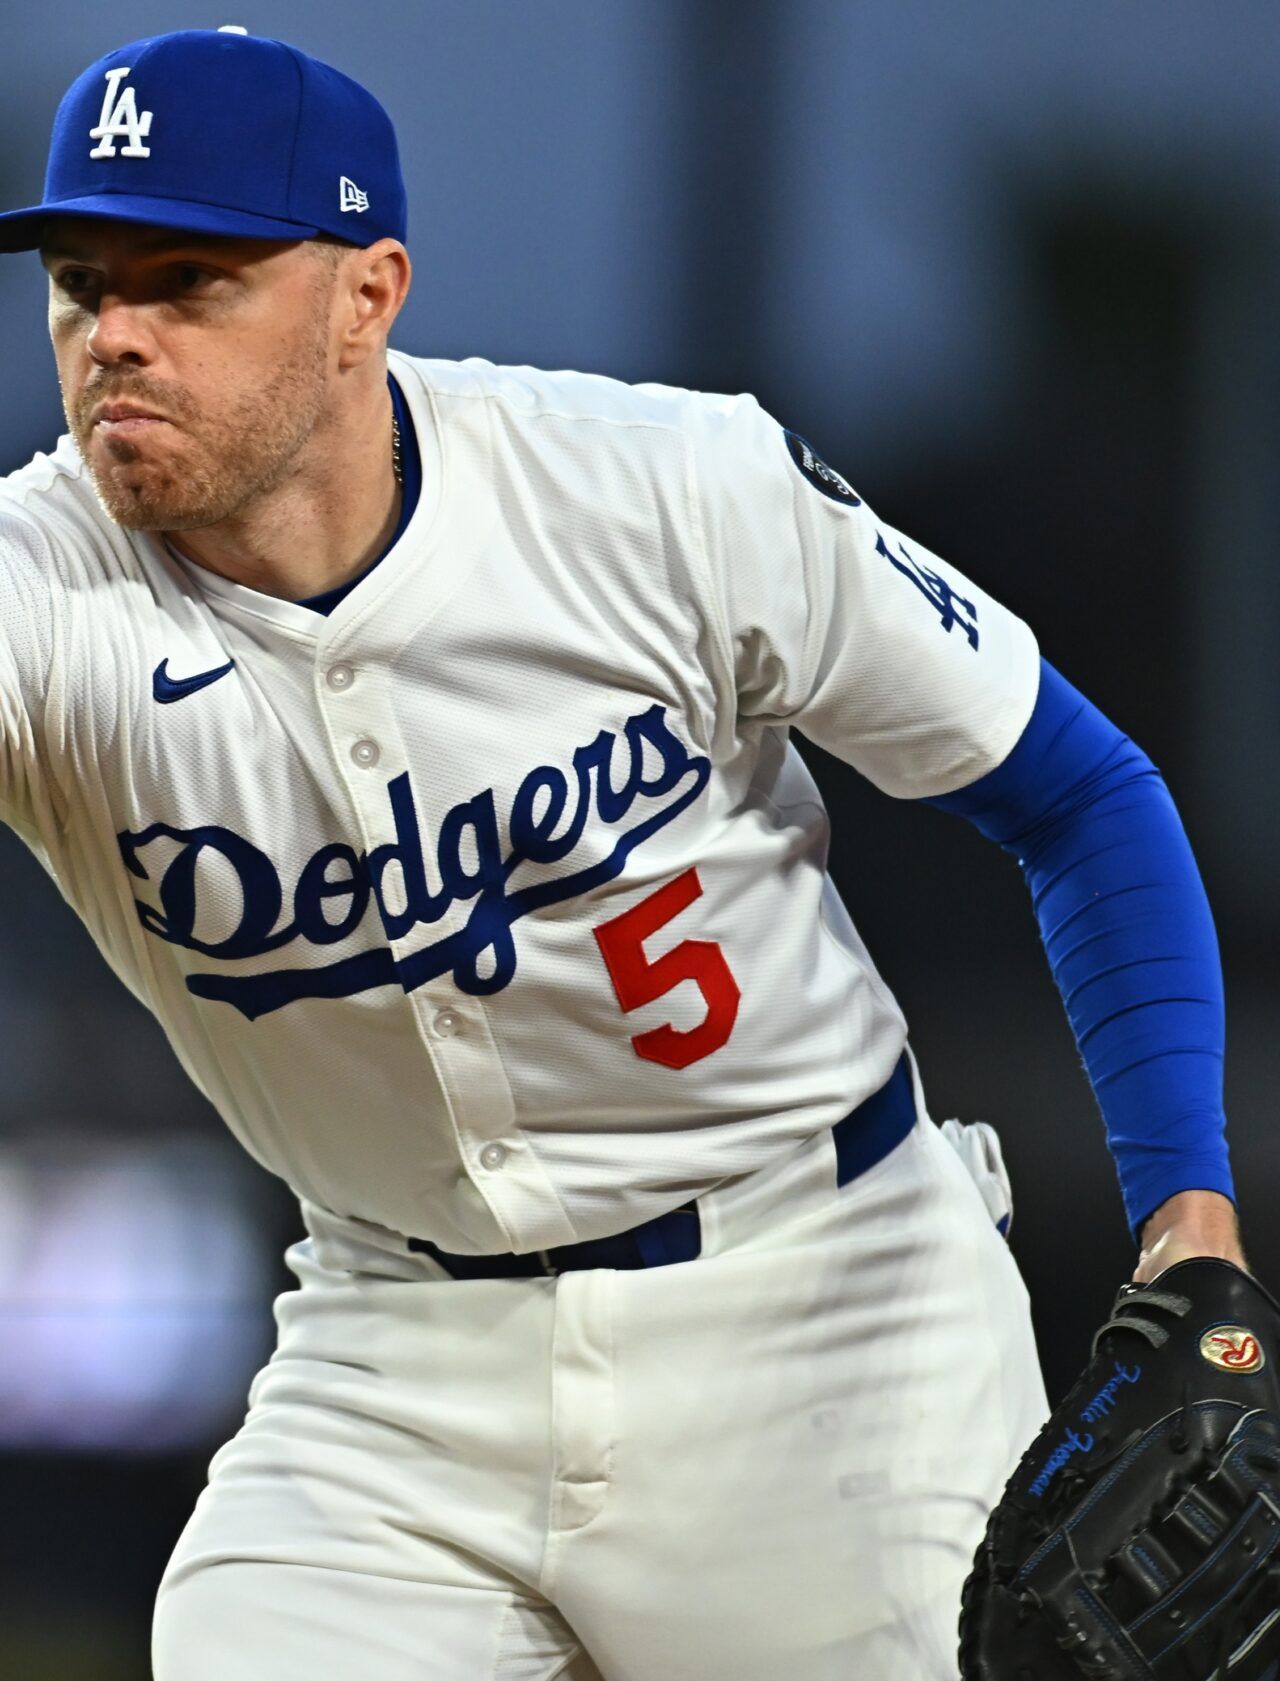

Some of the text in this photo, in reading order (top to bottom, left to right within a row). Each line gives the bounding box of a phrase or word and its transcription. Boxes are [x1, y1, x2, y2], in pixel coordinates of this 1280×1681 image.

[118, 704, 711, 1020] Dodgers
[593, 866, 742, 1071] 5
[1080, 1362, 1142, 1423] Freddie
